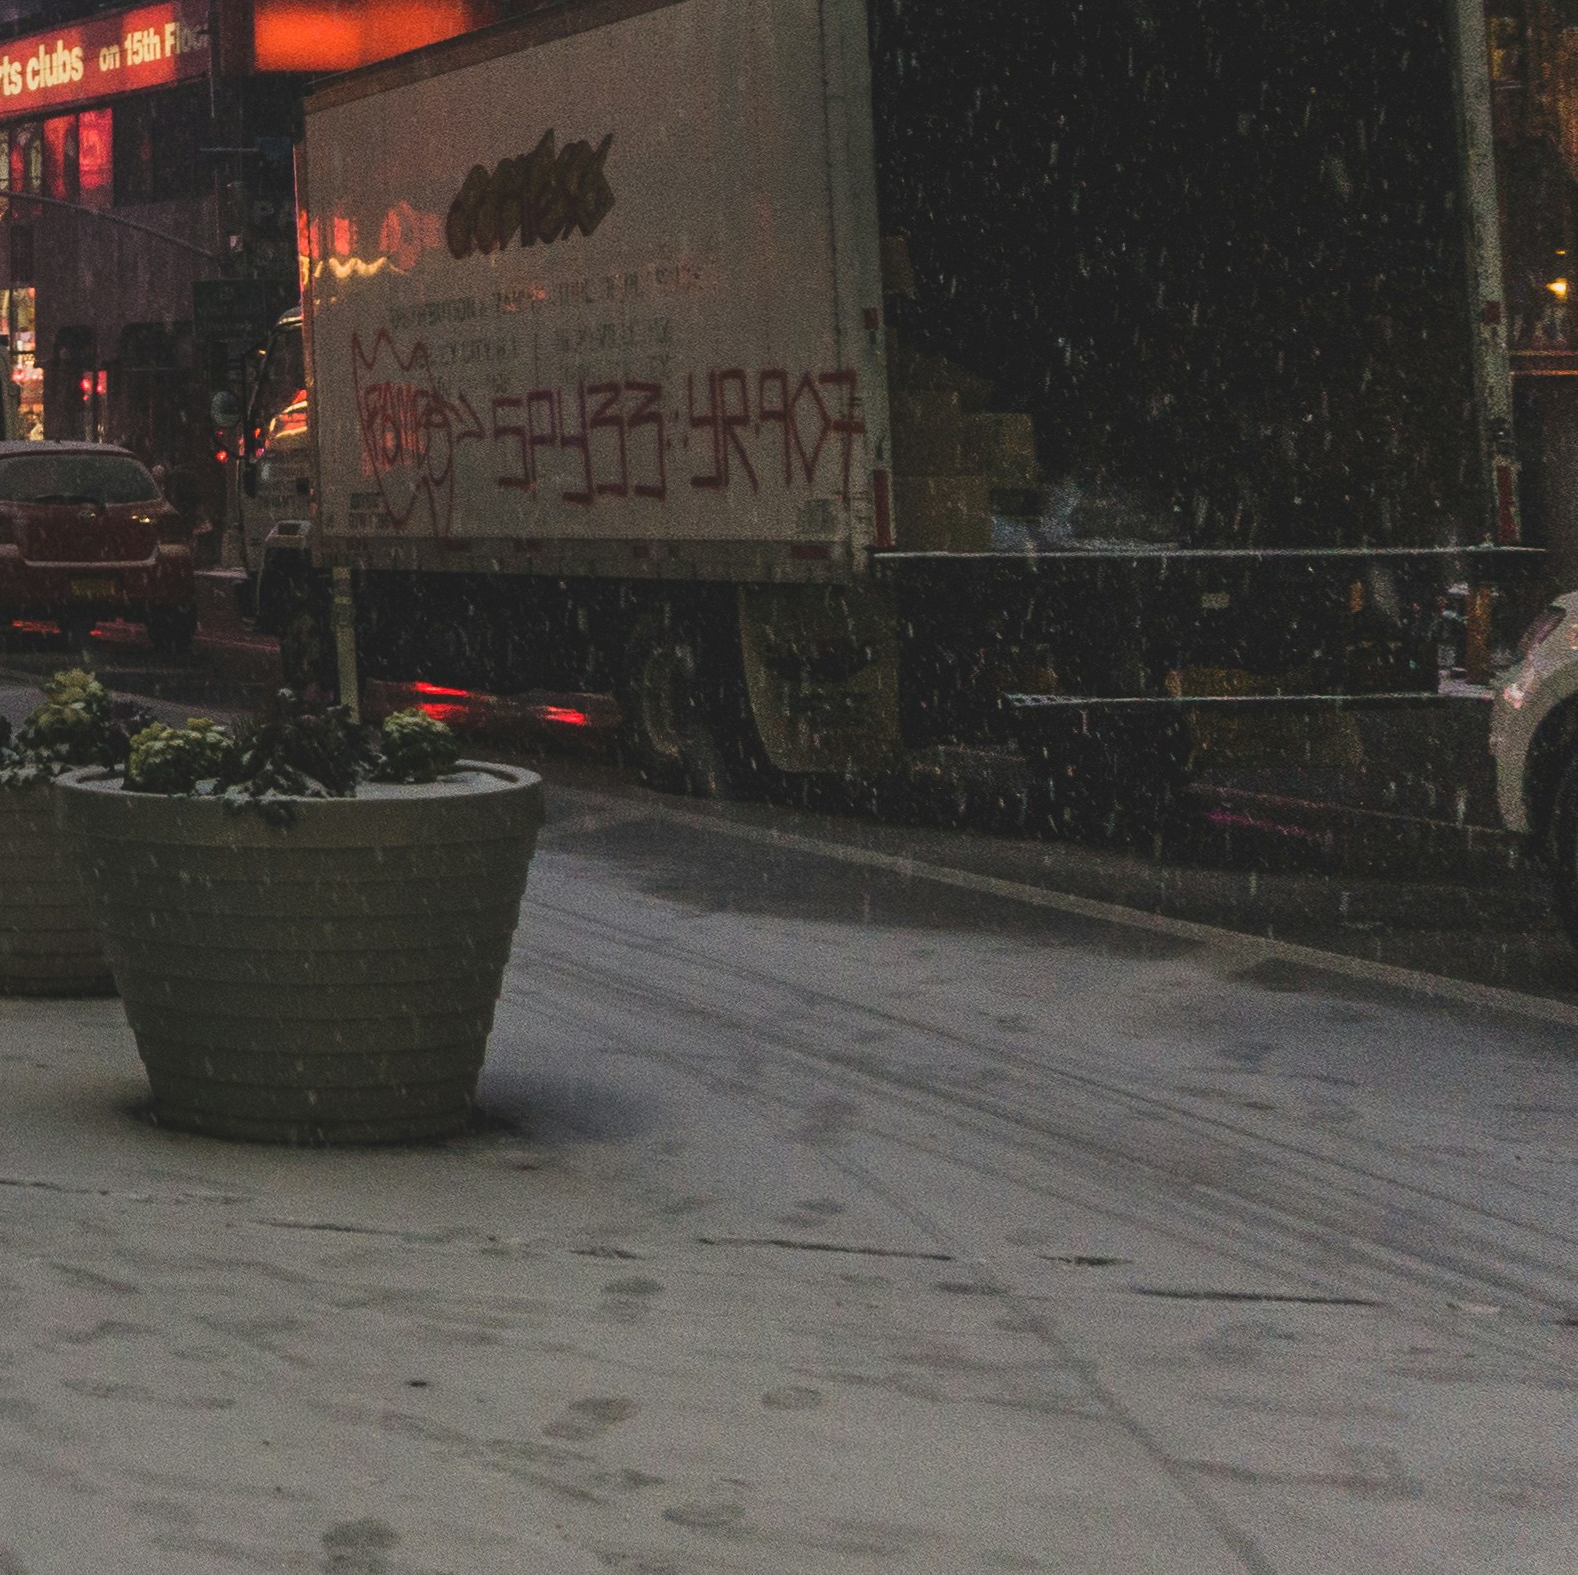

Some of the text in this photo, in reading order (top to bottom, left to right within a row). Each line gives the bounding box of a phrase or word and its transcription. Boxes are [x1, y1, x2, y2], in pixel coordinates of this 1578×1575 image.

[26, 39, 85, 86] clubs
[99, 42, 120, 72] on
[124, 28, 161, 67] 15th
